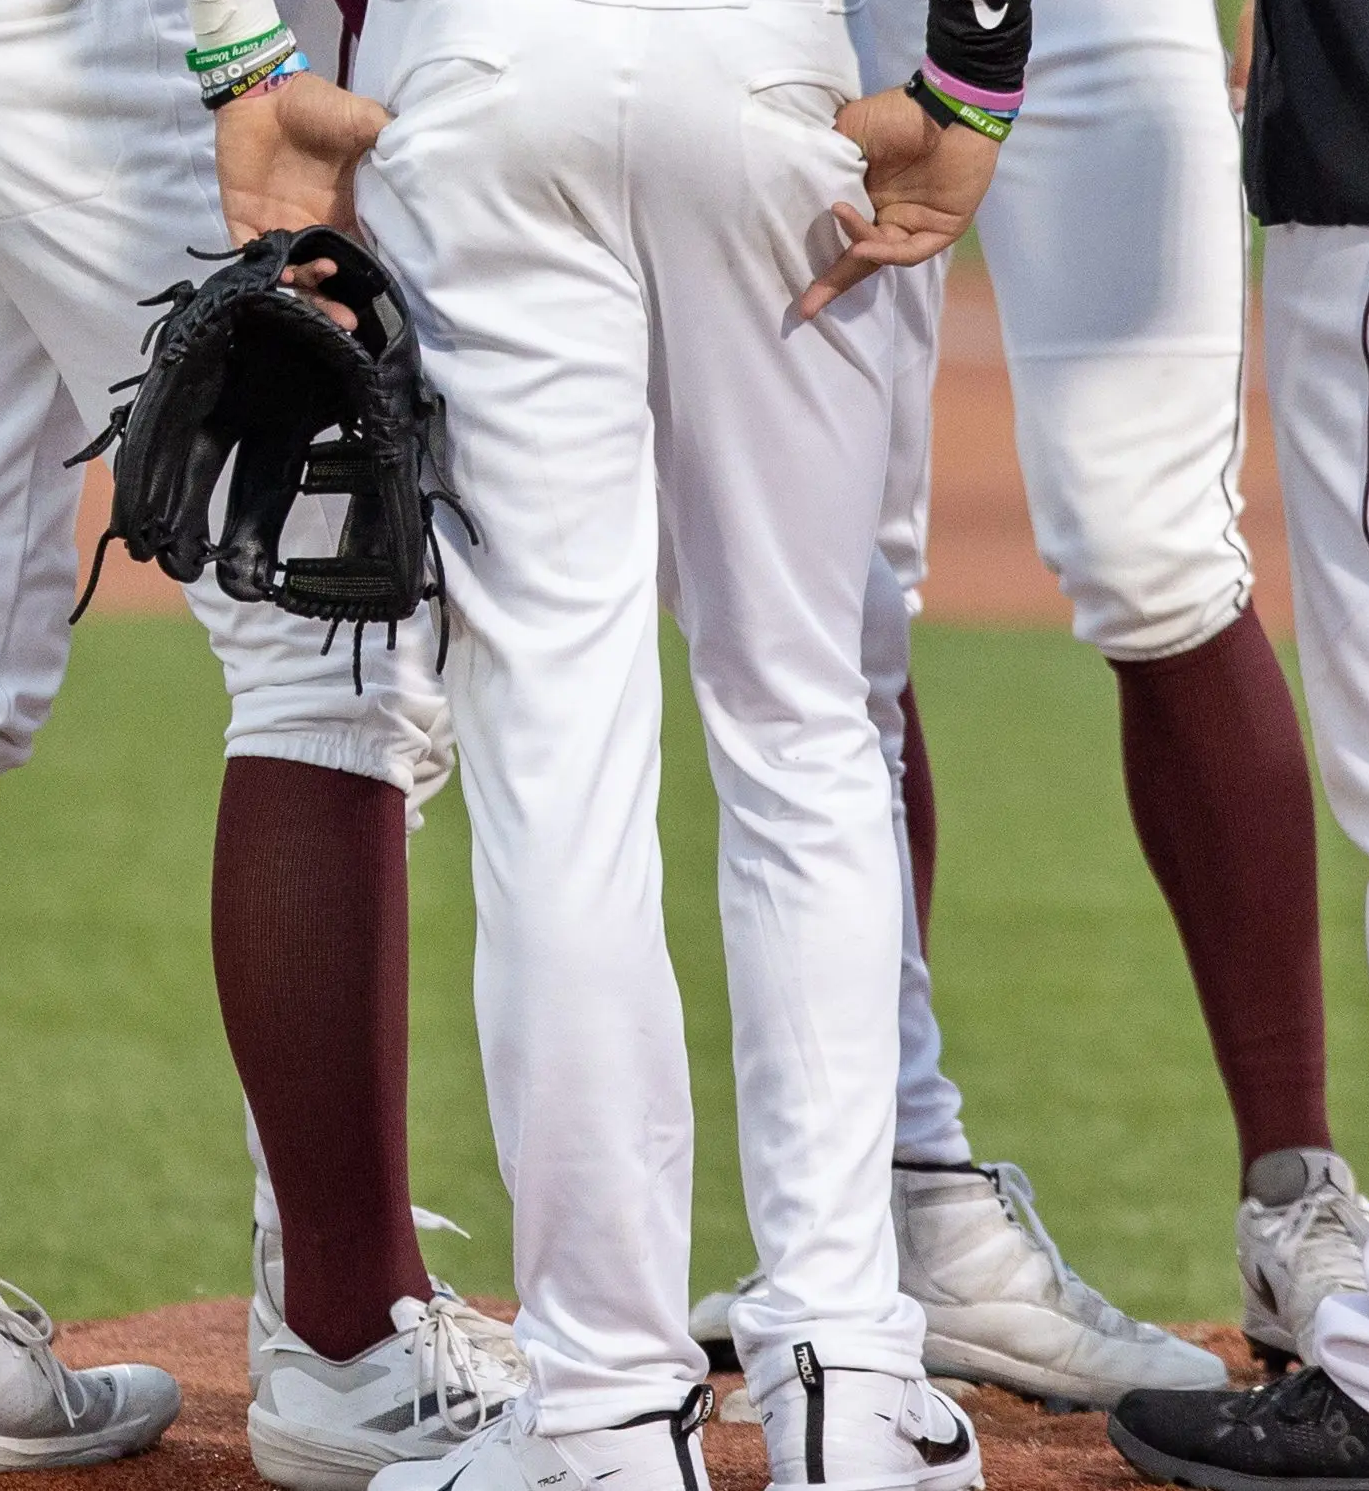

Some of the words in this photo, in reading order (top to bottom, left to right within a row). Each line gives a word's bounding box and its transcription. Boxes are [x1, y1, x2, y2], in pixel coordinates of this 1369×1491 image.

[231, 81, 247, 96] Be
[797, 1346, 817, 1385] TROUT
[537, 1470, 568, 1489] TROUT
